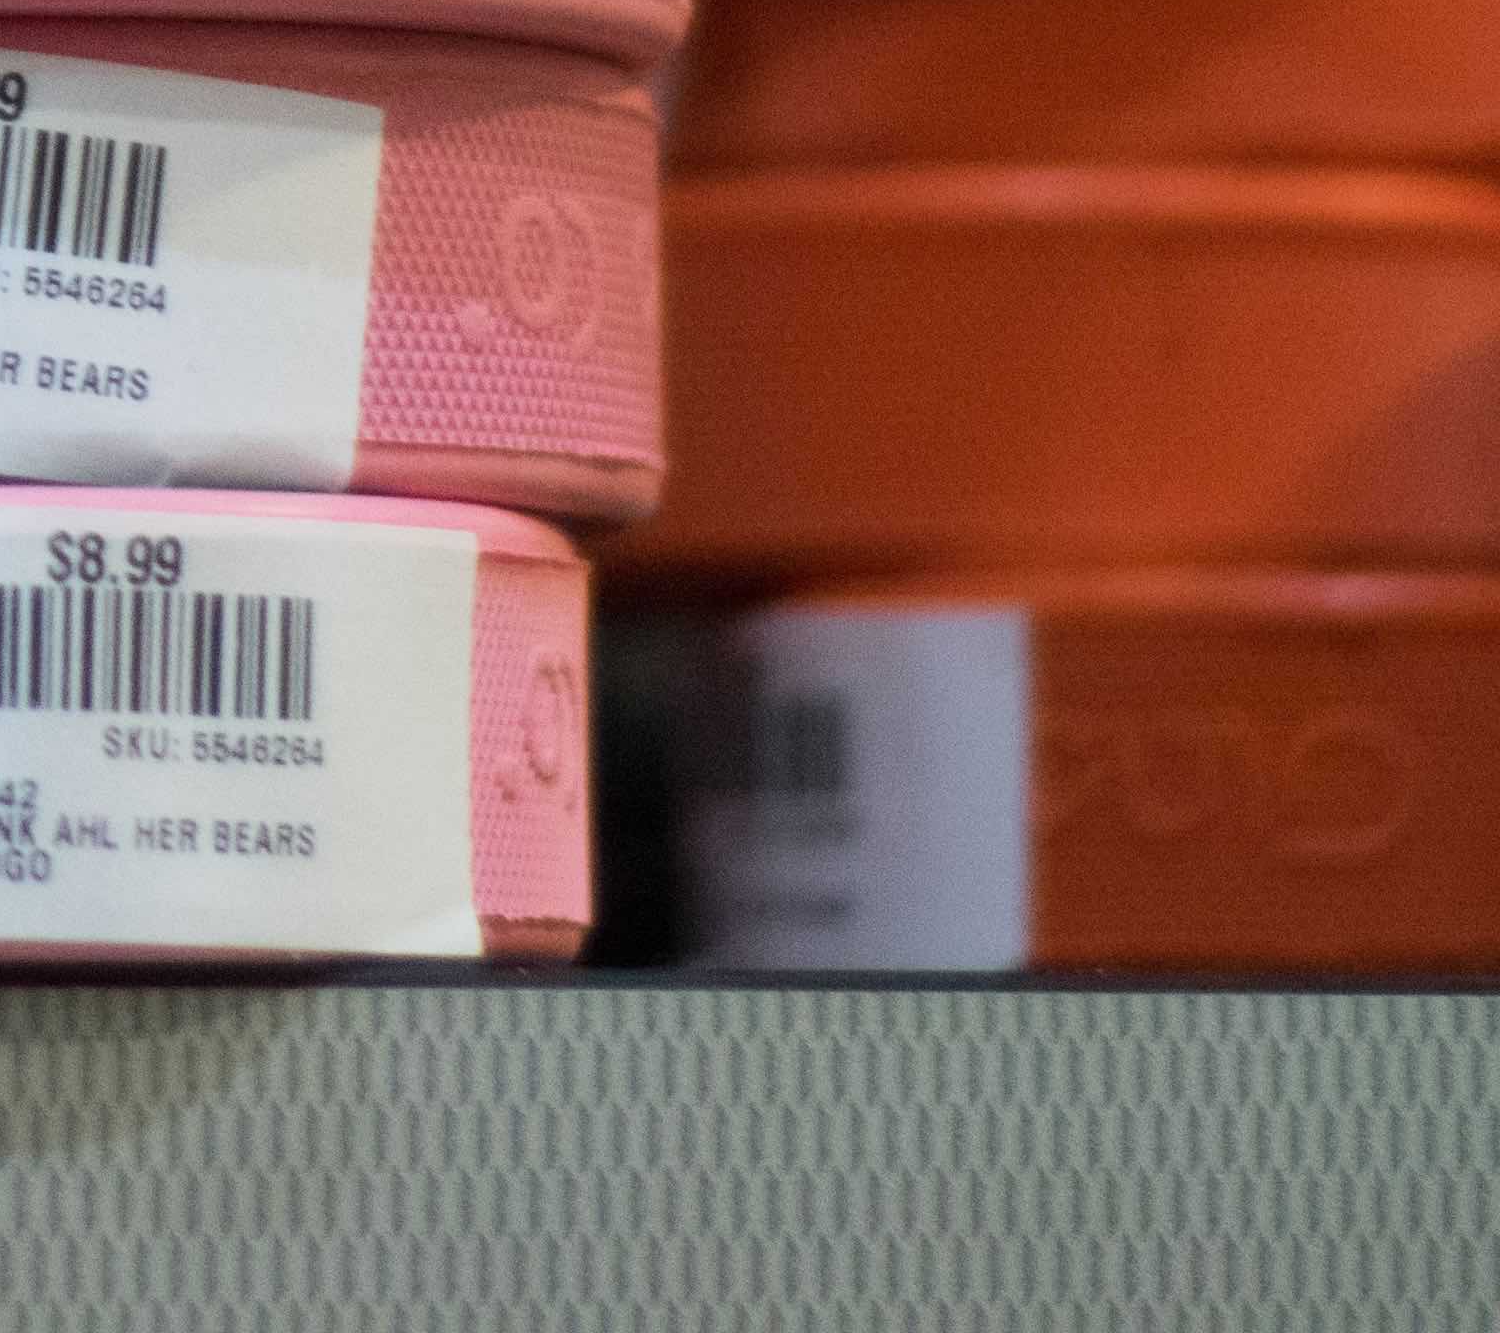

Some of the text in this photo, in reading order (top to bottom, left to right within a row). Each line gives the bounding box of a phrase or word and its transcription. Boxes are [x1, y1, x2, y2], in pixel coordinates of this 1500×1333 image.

[22, 267, 167, 314] 5546264
[36, 355, 151, 402] BEARS
[47, 531, 184, 587] $8.99
[103, 726, 324, 766] SKU: 5546264
[52, 813, 119, 852] AHL
[133, 817, 201, 853] HER
[211, 818, 317, 858] BEARS
